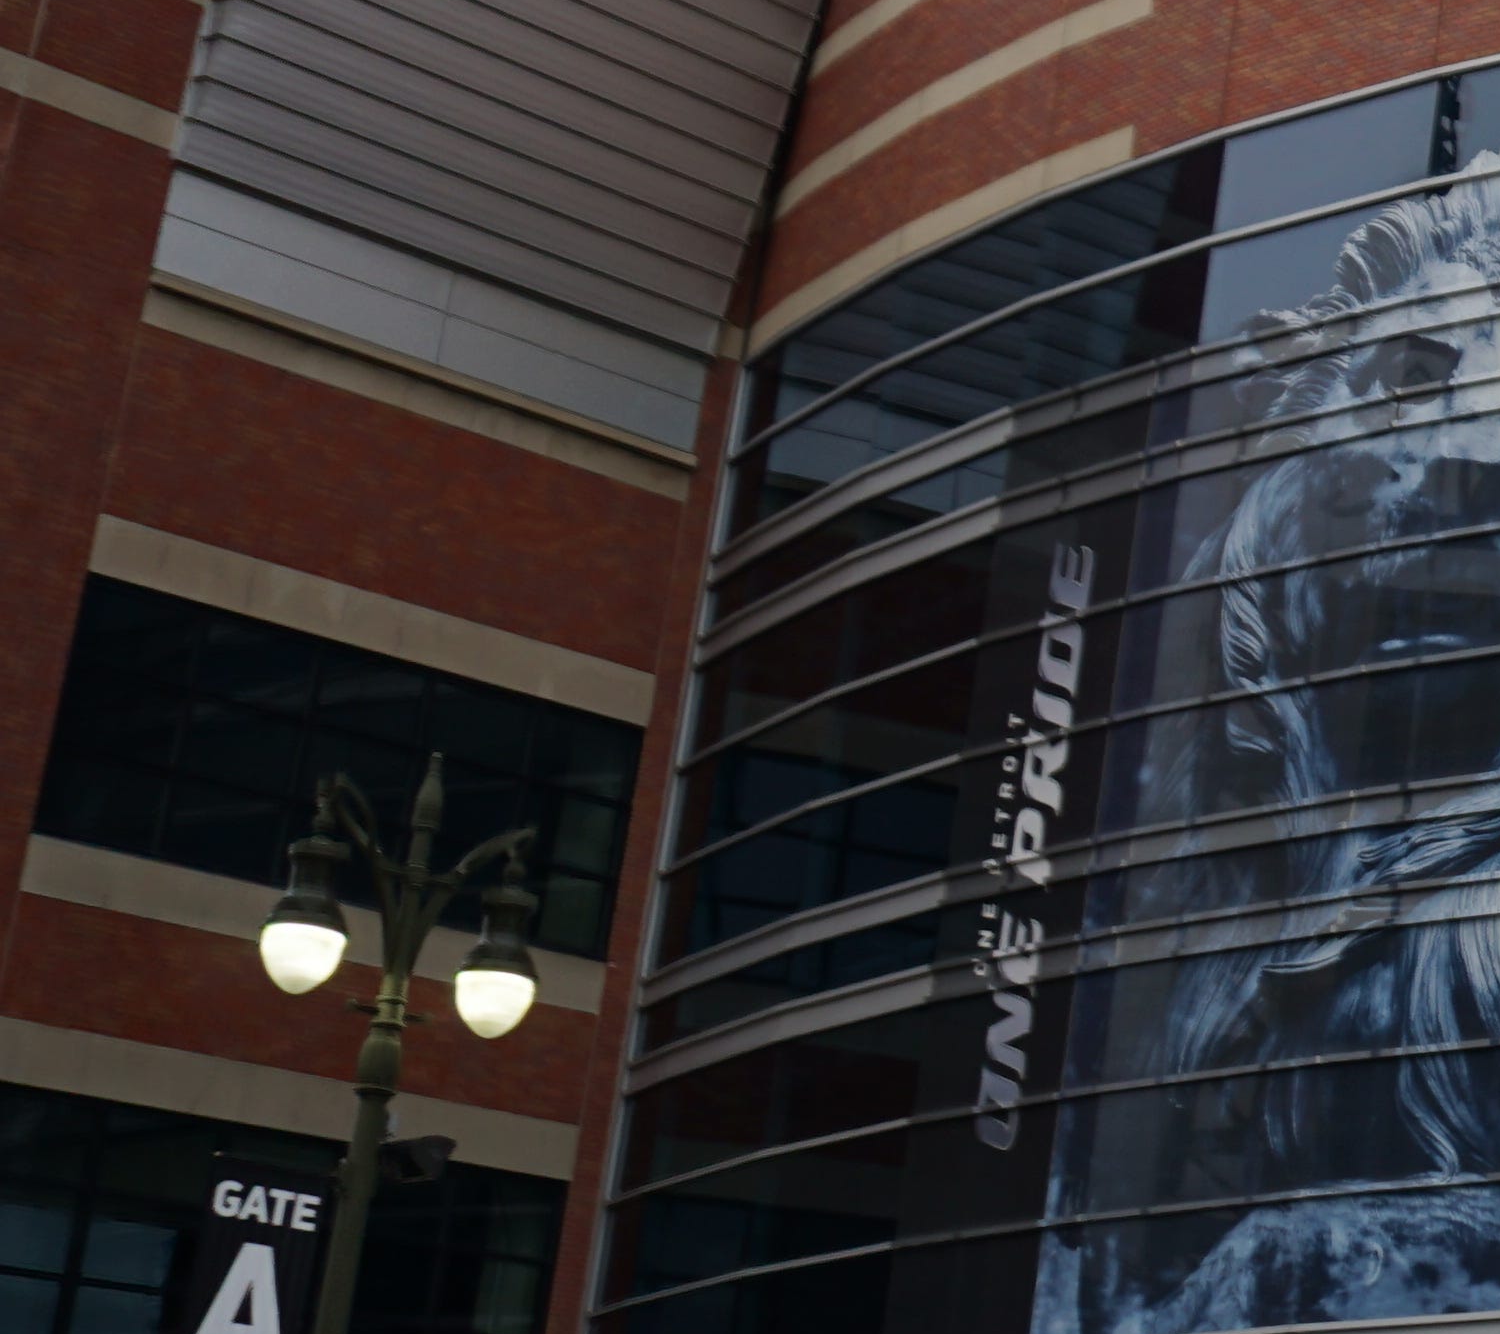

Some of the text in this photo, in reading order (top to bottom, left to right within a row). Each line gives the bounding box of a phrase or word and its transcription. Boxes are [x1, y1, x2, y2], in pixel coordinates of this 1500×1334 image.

[974, 541, 1096, 1153] ONE PRIDE
[211, 1179, 323, 1233] GATE
